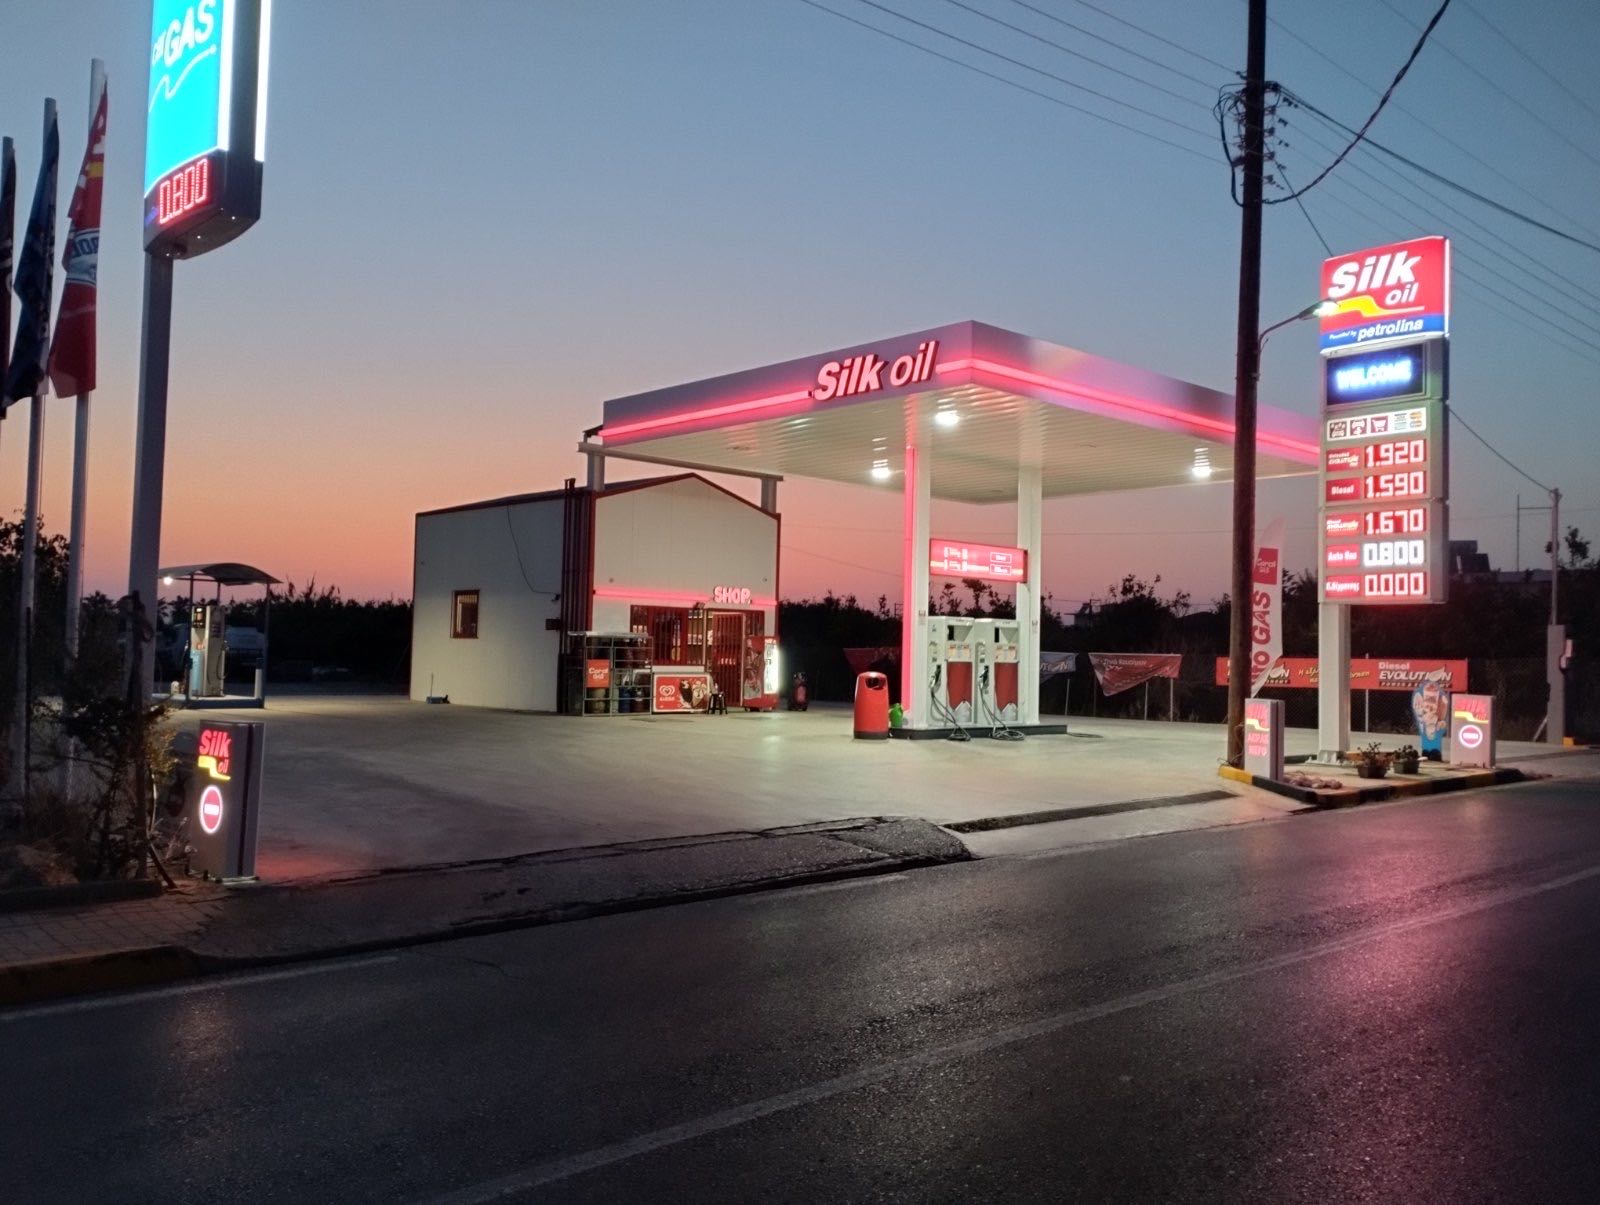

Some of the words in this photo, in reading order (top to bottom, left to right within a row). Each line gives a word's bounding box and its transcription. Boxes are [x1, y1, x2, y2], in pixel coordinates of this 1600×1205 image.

[1327, 250, 1422, 298] Silk
[1384, 282, 1419, 305] oil
[1357, 319, 1424, 341] petrolina
[814, 353, 889, 401] Silk
[890, 340, 939, 387] oil
[1336, 360, 1412, 389] WELCOME
[1365, 440, 1425, 467] 1.920
[1331, 485, 1355, 495] Diesel
[1365, 471, 1425, 498] 1.590
[1365, 508, 1425, 535] 1.670
[713, 585, 751, 604] SHOP
[1364, 571, 1425, 596] 0.000
[1252, 590, 1271, 645] GAS
[1378, 661, 1410, 670] Diesel
[198, 729, 231, 758] Silk
[218, 759, 229, 773] oil
